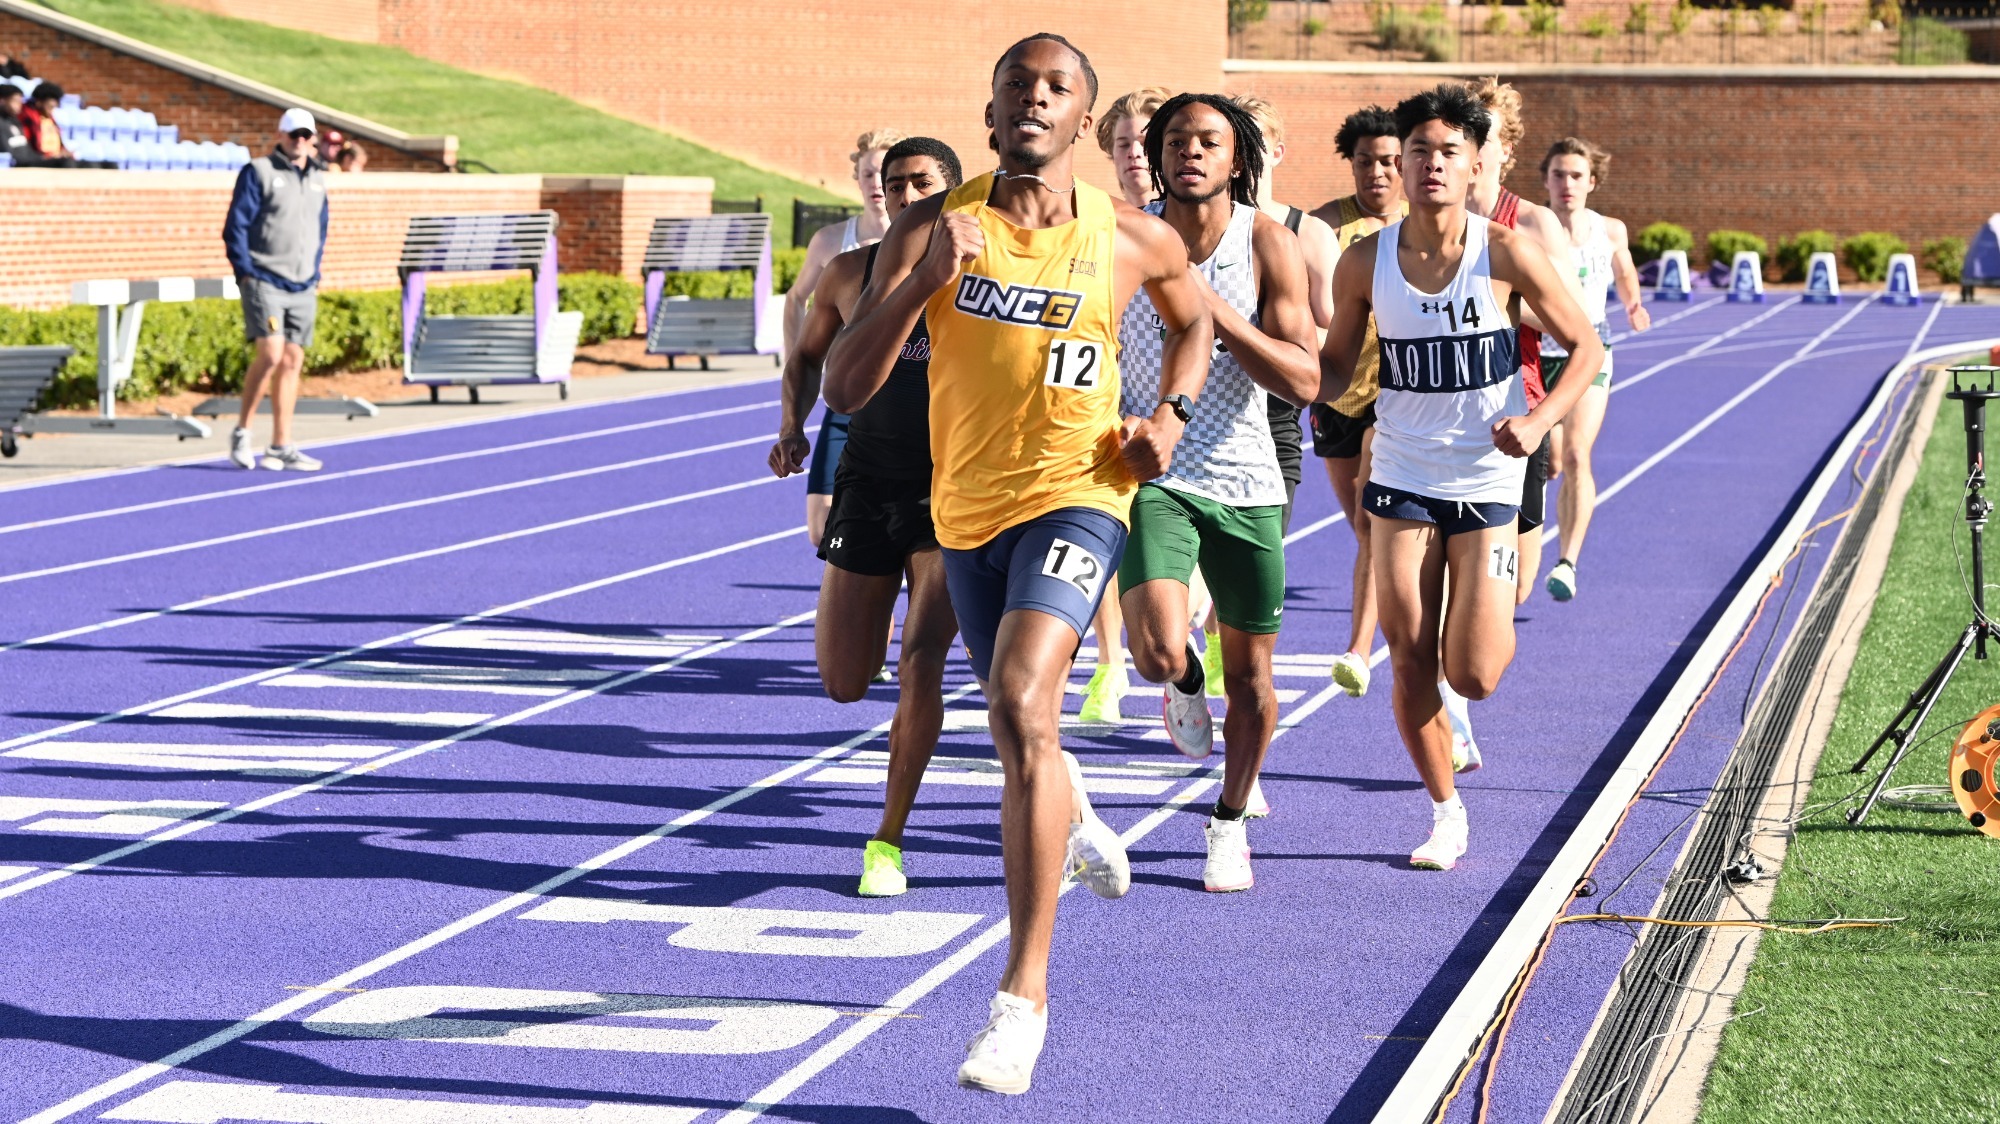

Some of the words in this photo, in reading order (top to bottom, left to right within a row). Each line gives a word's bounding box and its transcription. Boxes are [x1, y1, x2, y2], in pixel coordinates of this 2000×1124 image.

[1738, 269, 1753, 291] 3
[1813, 270, 1828, 290] 2
[1895, 271, 1906, 291] 1
[955, 273, 1085, 330] UNCG
[1442, 297, 1480, 332] 14
[1051, 342, 1097, 387] 12
[1384, 336, 1495, 388] MOUNT
[1052, 544, 1098, 595] 12
[1493, 546, 1516, 581] 14
